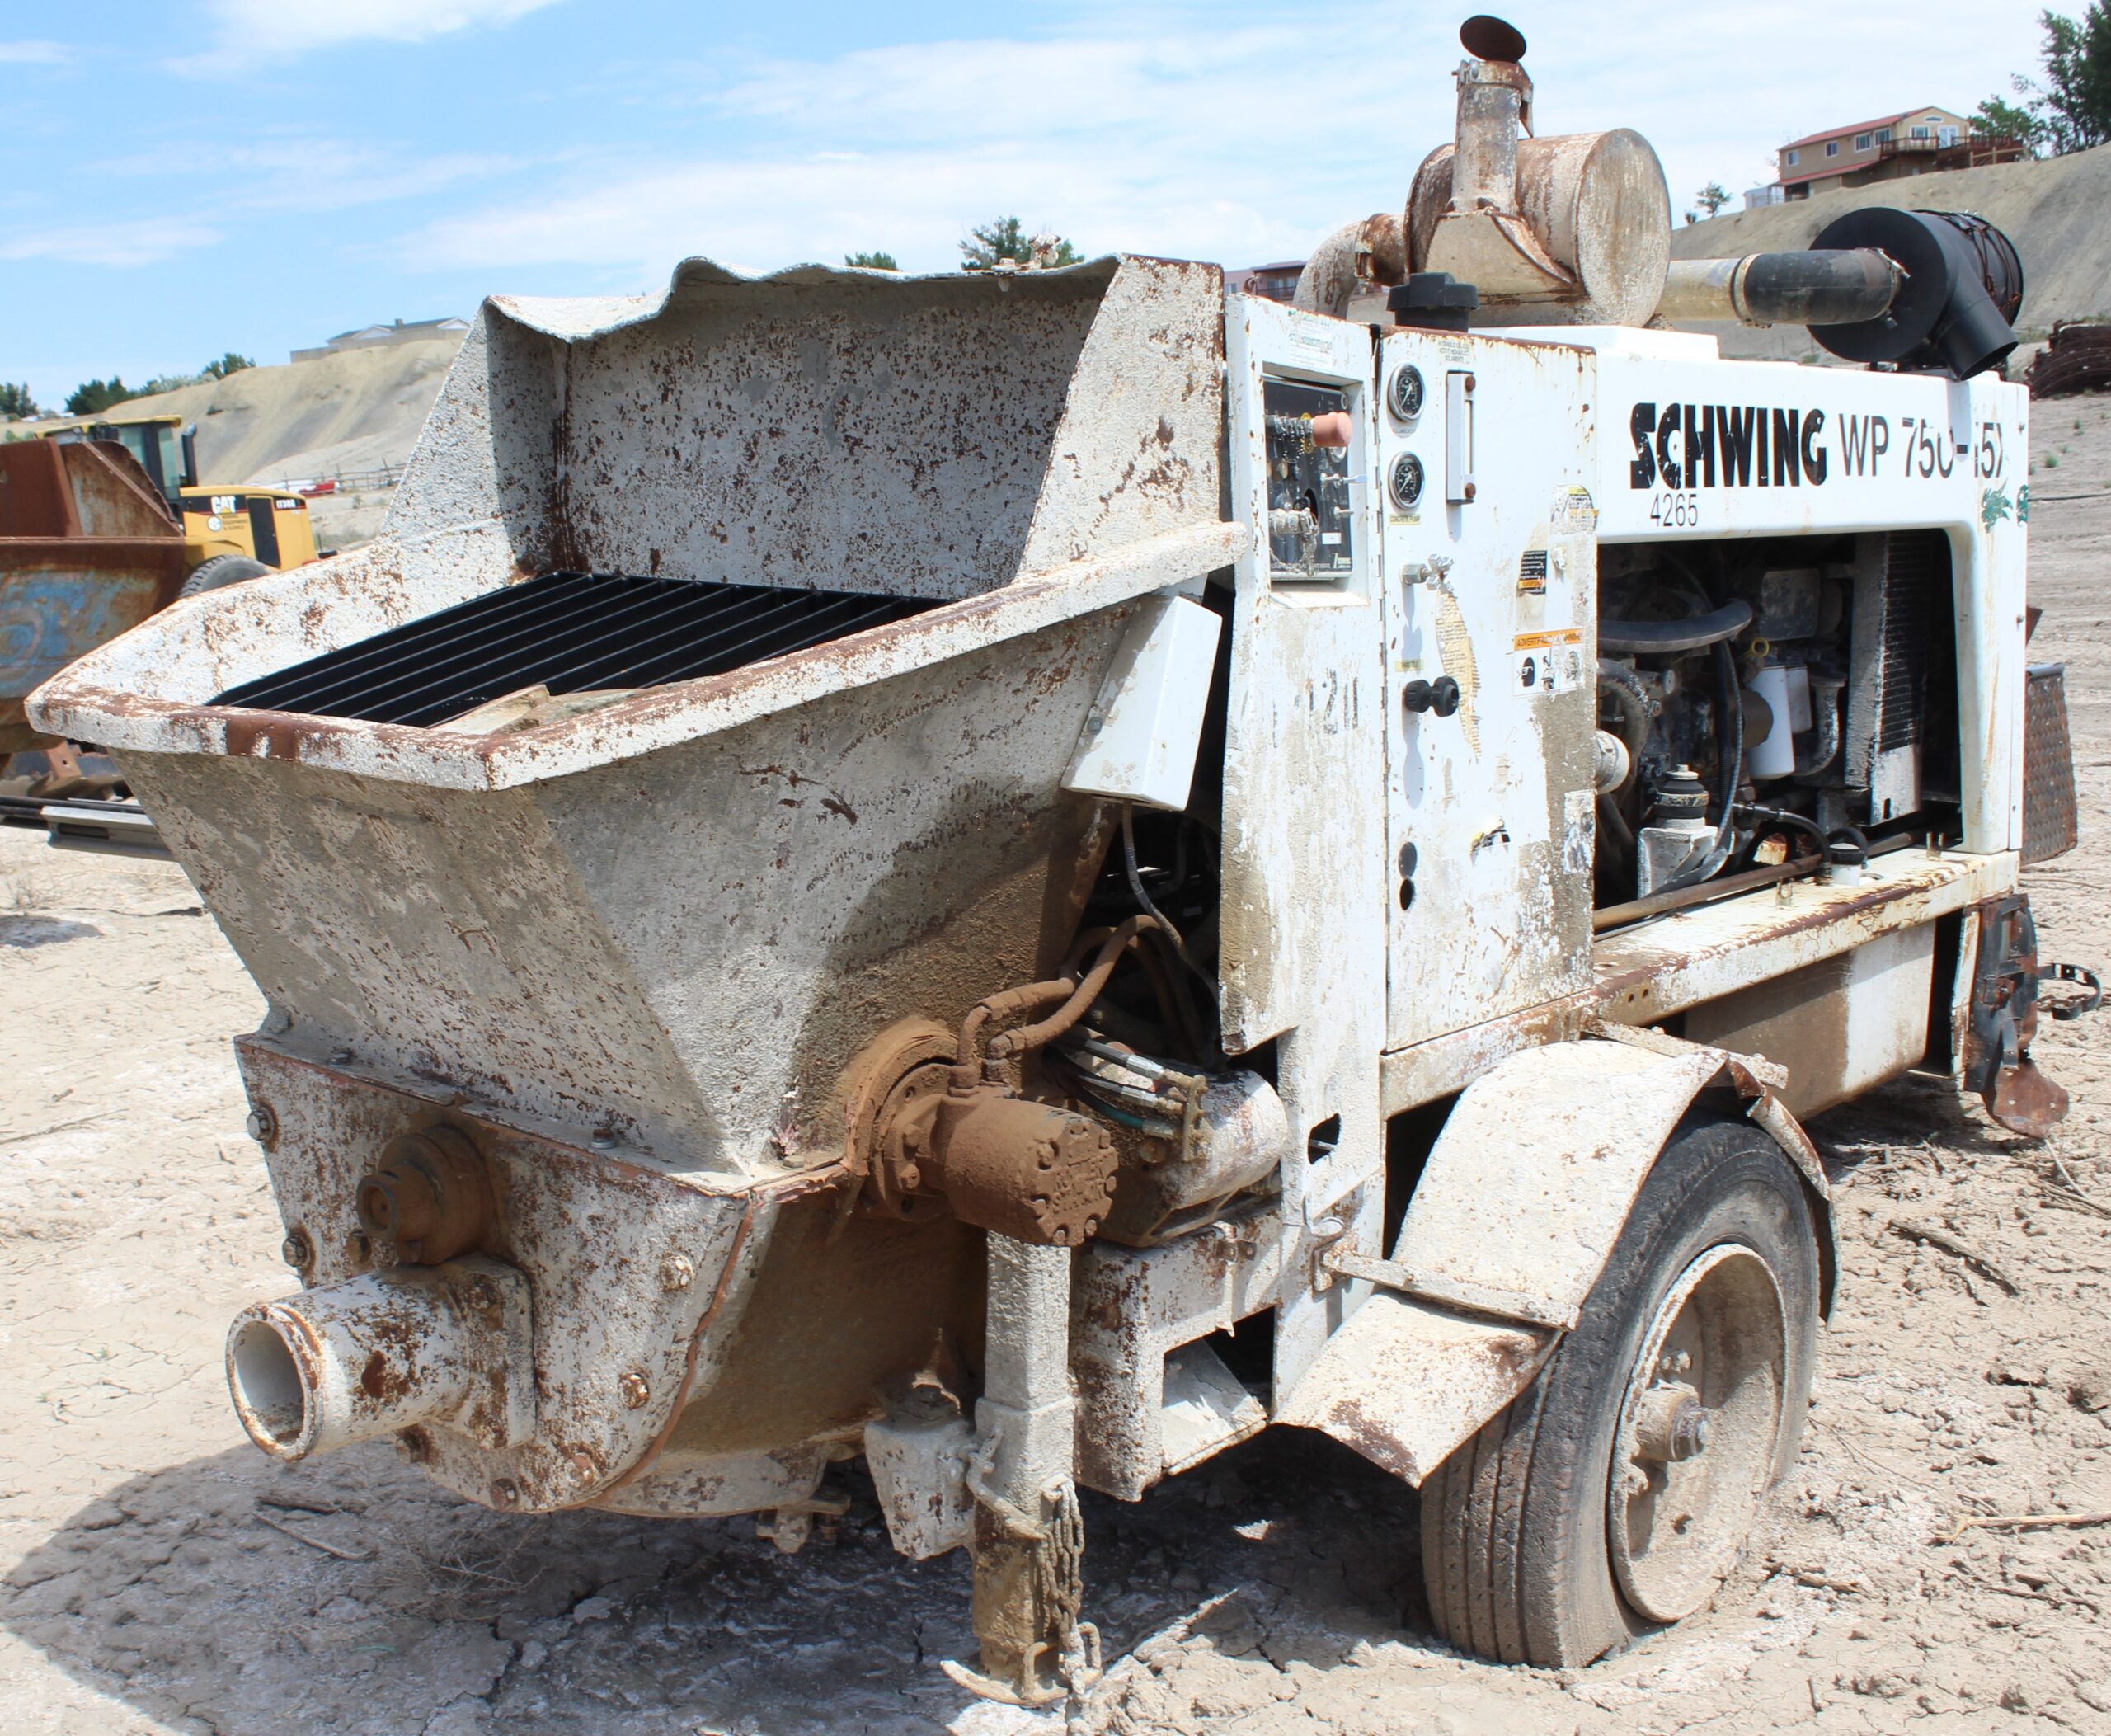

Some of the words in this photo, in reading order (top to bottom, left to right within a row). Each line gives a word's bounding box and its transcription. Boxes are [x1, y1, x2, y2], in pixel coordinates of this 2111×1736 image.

[1630, 402, 1827, 490] SCHWING
[1838, 413, 1889, 478] WP
[210, 495, 236, 514] CAT
[1650, 493, 1699, 527] 4265
